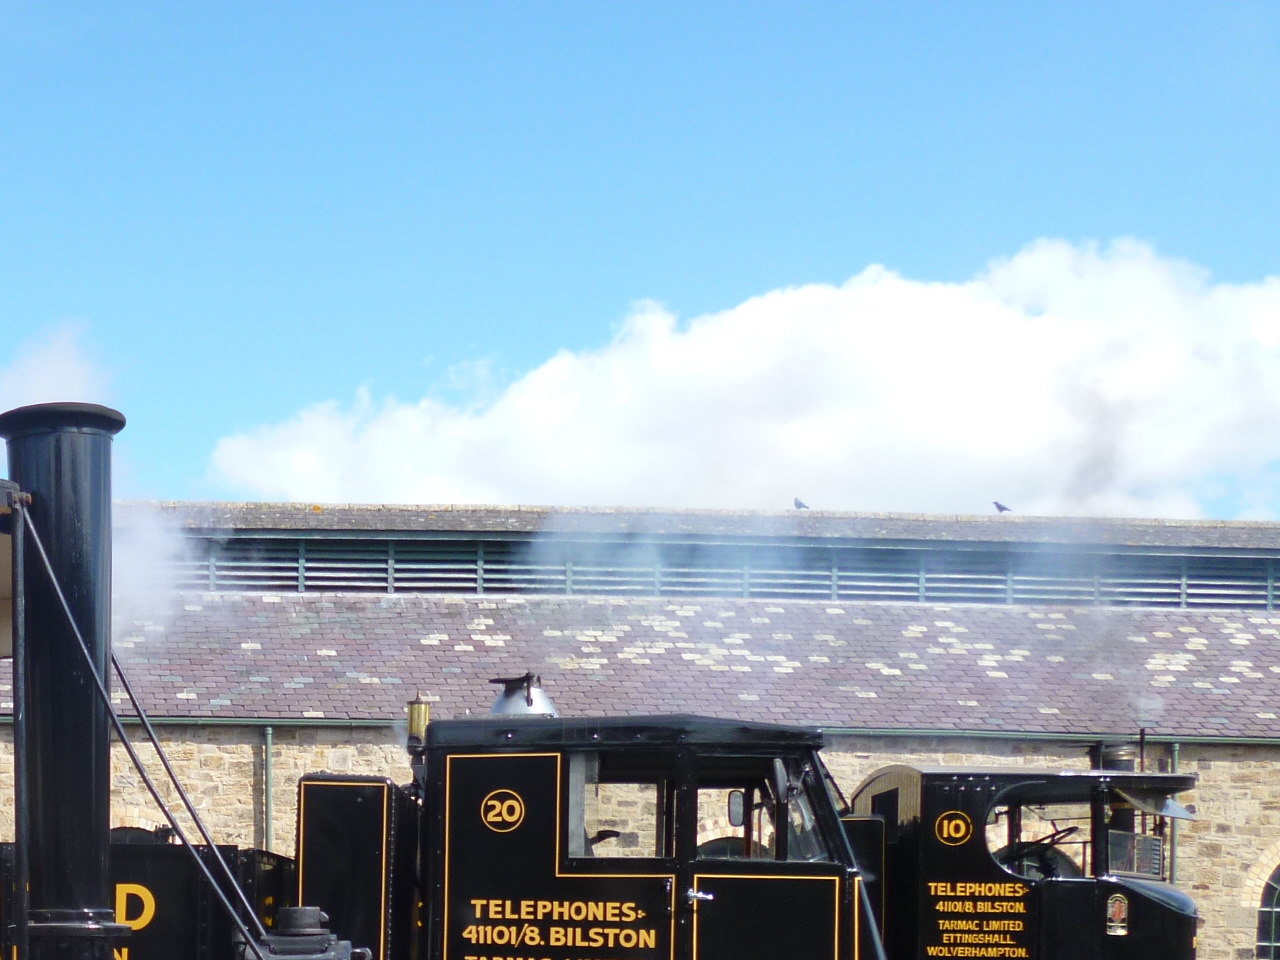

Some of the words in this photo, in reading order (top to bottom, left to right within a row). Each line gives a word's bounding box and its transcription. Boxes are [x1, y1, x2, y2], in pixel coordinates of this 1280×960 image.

[486, 799, 522, 823] 20
[942, 819, 967, 839] 10
[937, 919, 981, 931] TARMAC
[461, 923, 546, 948] 41101/8.
[549, 926, 656, 949] BILSTON
[926, 946, 1029, 959] WOLVERHAMPTON.
